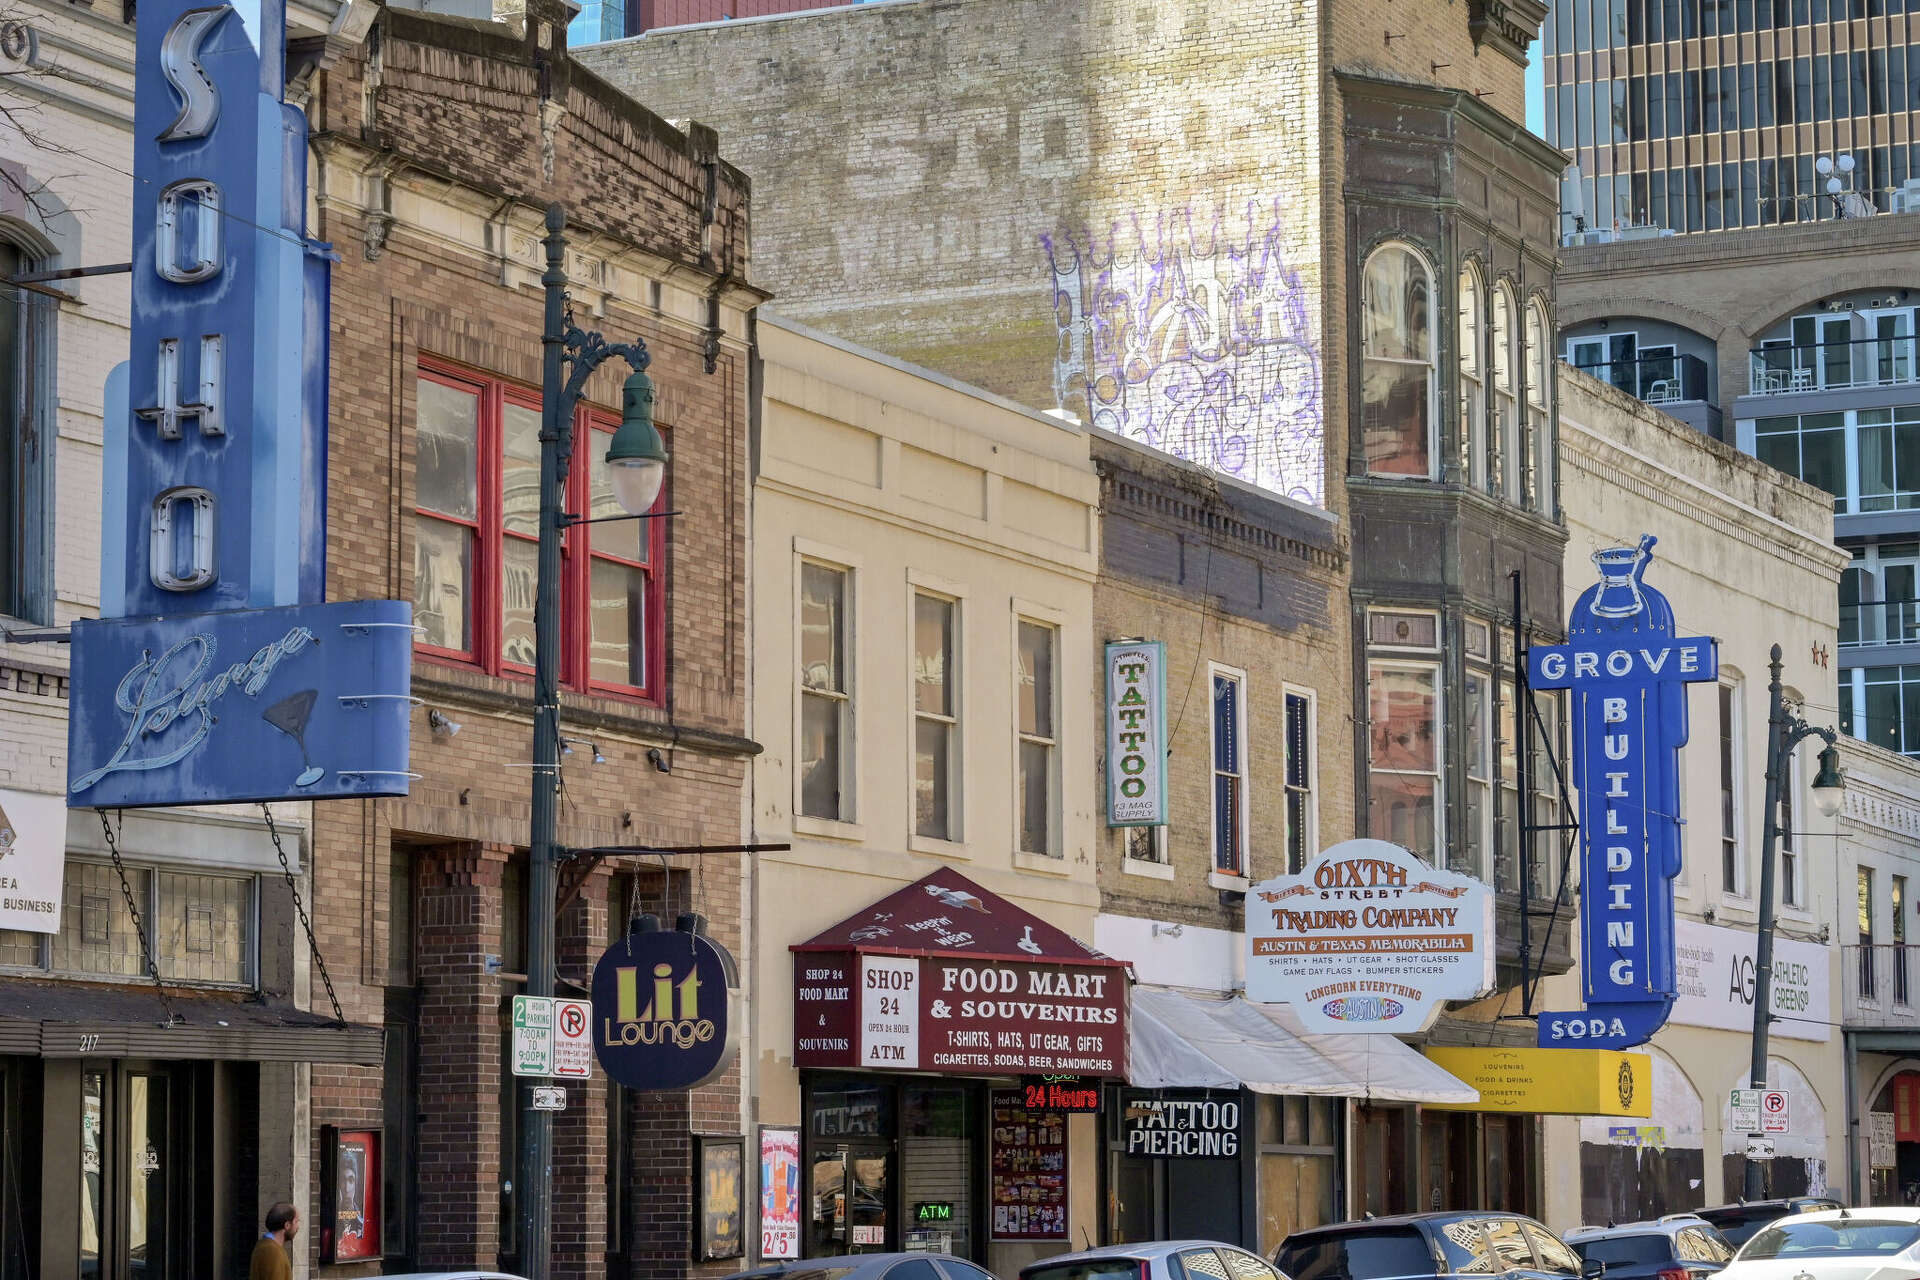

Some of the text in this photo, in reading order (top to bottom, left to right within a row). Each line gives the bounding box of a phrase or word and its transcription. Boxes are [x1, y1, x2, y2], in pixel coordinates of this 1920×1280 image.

[136, 5, 234, 592] SOHO
[1541, 646, 1699, 680] GROVE
[71, 627, 314, 793] Lounge
[1118, 663, 1146, 798] TATTOO
[1128, 802, 1153, 810] MAG
[1604, 698, 1634, 985] BUILDING
[10, 878, 18, 890] A
[1320, 889, 1403, 900] STREET
[4, 898, 56, 914] BUSINESS!
[1272, 906, 1458, 933] TRADING COMPANY
[1260, 938, 1465, 952] AUSTIN & TEXAS MEMORABILIA
[1360, 956, 1382, 964] GEAR
[806, 969, 843, 980] SHOP 24
[867, 969, 914, 990] SHOP
[1283, 968, 1306, 976] GAME
[1774, 961, 1808, 986] ATHLETIC
[942, 967, 1106, 999] FOOD MART
[1305, 980, 1422, 1002] LONGHORN EVERYTHING
[616, 962, 702, 1024] Lit
[799, 987, 849, 1001] FOOD MART
[516, 1002, 524, 1022] 2
[880, 997, 899, 1015] 24
[930, 999, 1118, 1024] & SOUVENIRS
[527, 1014, 550, 1024] PARKING
[818, 1013, 826, 1026] &
[868, 1023, 884, 1033] OPEN
[894, 1024, 909, 1033] HOUR
[520, 1028, 546, 1039] 7:00AM
[605, 1017, 715, 1049] Lounge
[1551, 1018, 1627, 1040] SODA
[80, 1034, 99, 1052] 217
[528, 1040, 537, 1050] TO
[799, 1038, 849, 1050] SOUVENIRS
[947, 1030, 1103, 1053] T-SHIRTS, HATS, UT GEAR, GIFTS
[519, 1051, 546, 1061] 9:00PM
[870, 1045, 904, 1060] ATM
[934, 1053, 1113, 1071] CIGARETTES, SODAS, BEER, SANDWICHES
[1026, 1085, 1097, 1108] 24 Hours
[1732, 1092, 1739, 1105] 2
[1131, 1101, 1238, 1130] TATTOO
[1129, 1130, 1238, 1156] PIERCING
[919, 1205, 949, 1218] ATM
